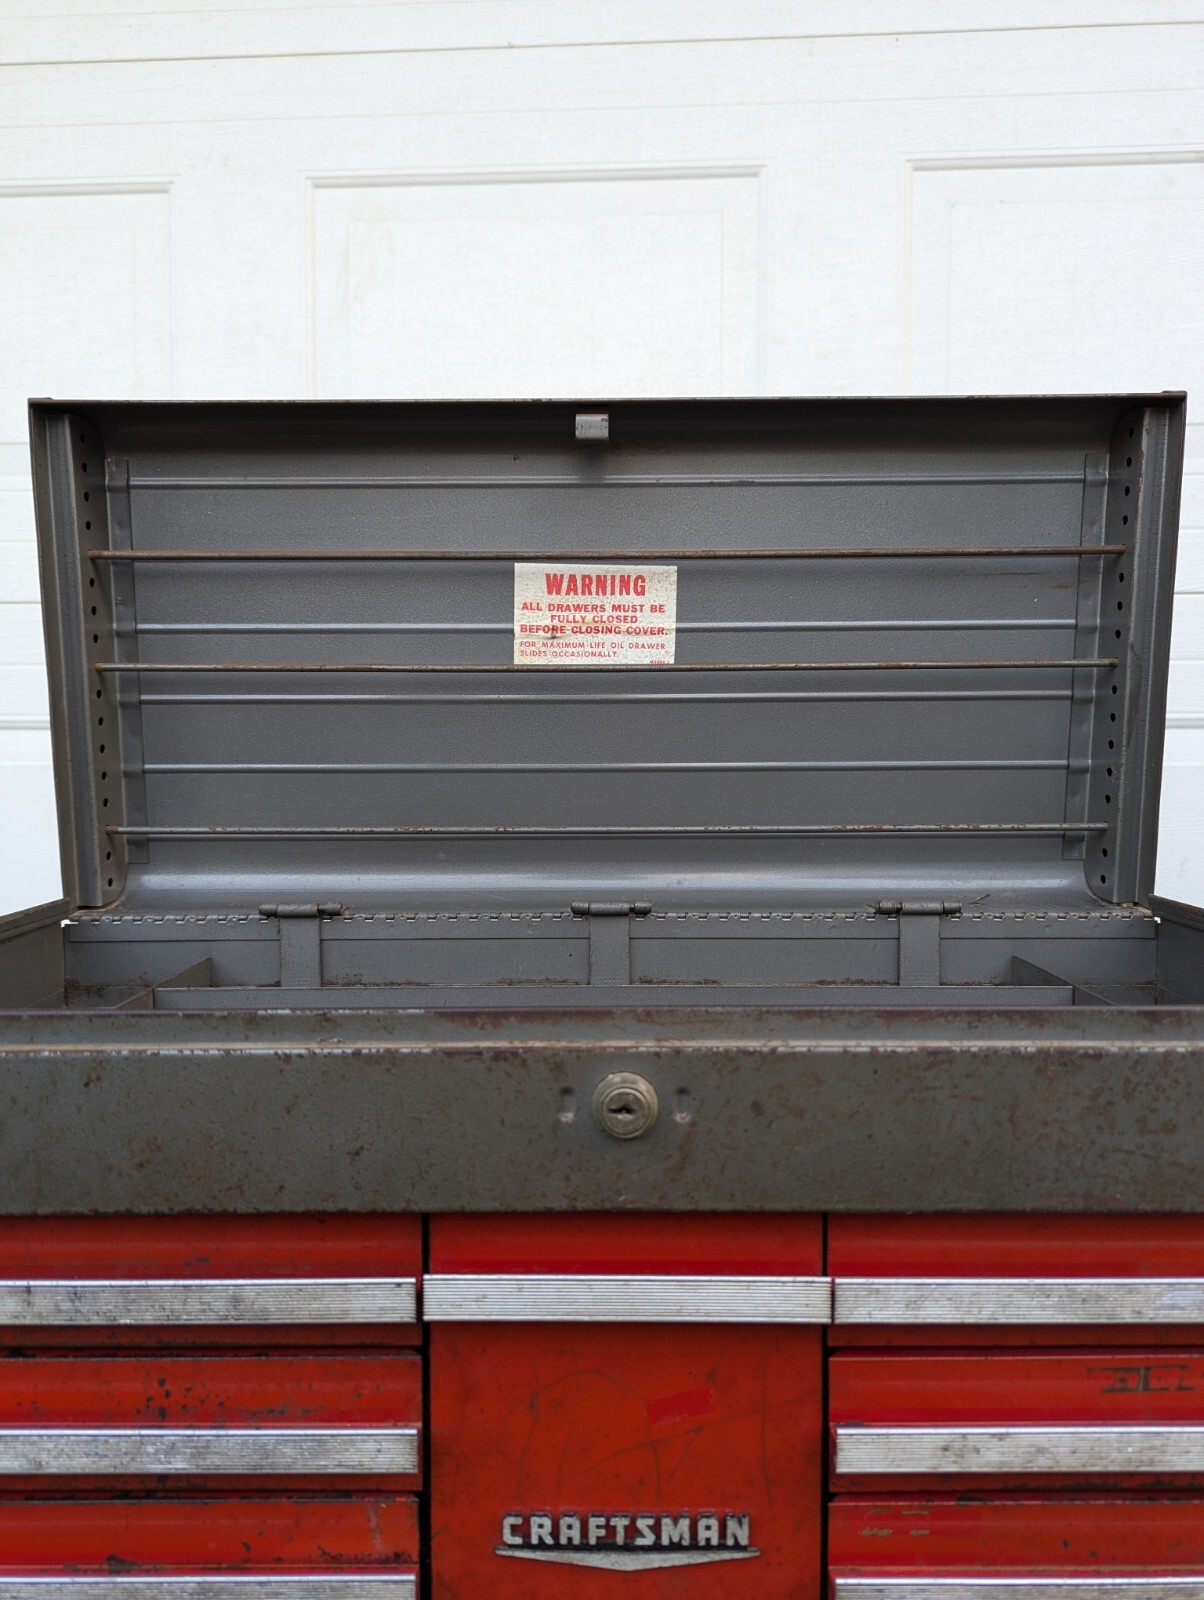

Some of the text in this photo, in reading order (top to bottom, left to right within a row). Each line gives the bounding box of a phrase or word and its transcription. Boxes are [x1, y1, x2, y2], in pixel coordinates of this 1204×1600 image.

[545, 573, 646, 596] WARNING
[522, 602, 665, 613] ALL DRAWERS MUST BE
[551, 615, 638, 624] FULLY CLOSED
[520, 625, 668, 635] BEFORE CLOSING COVER.
[520, 641, 536, 649] FOR
[590, 642, 605, 650] LIFE
[611, 642, 624, 650] OIL
[502, 1512, 749, 1546] CRAFTSMAN
